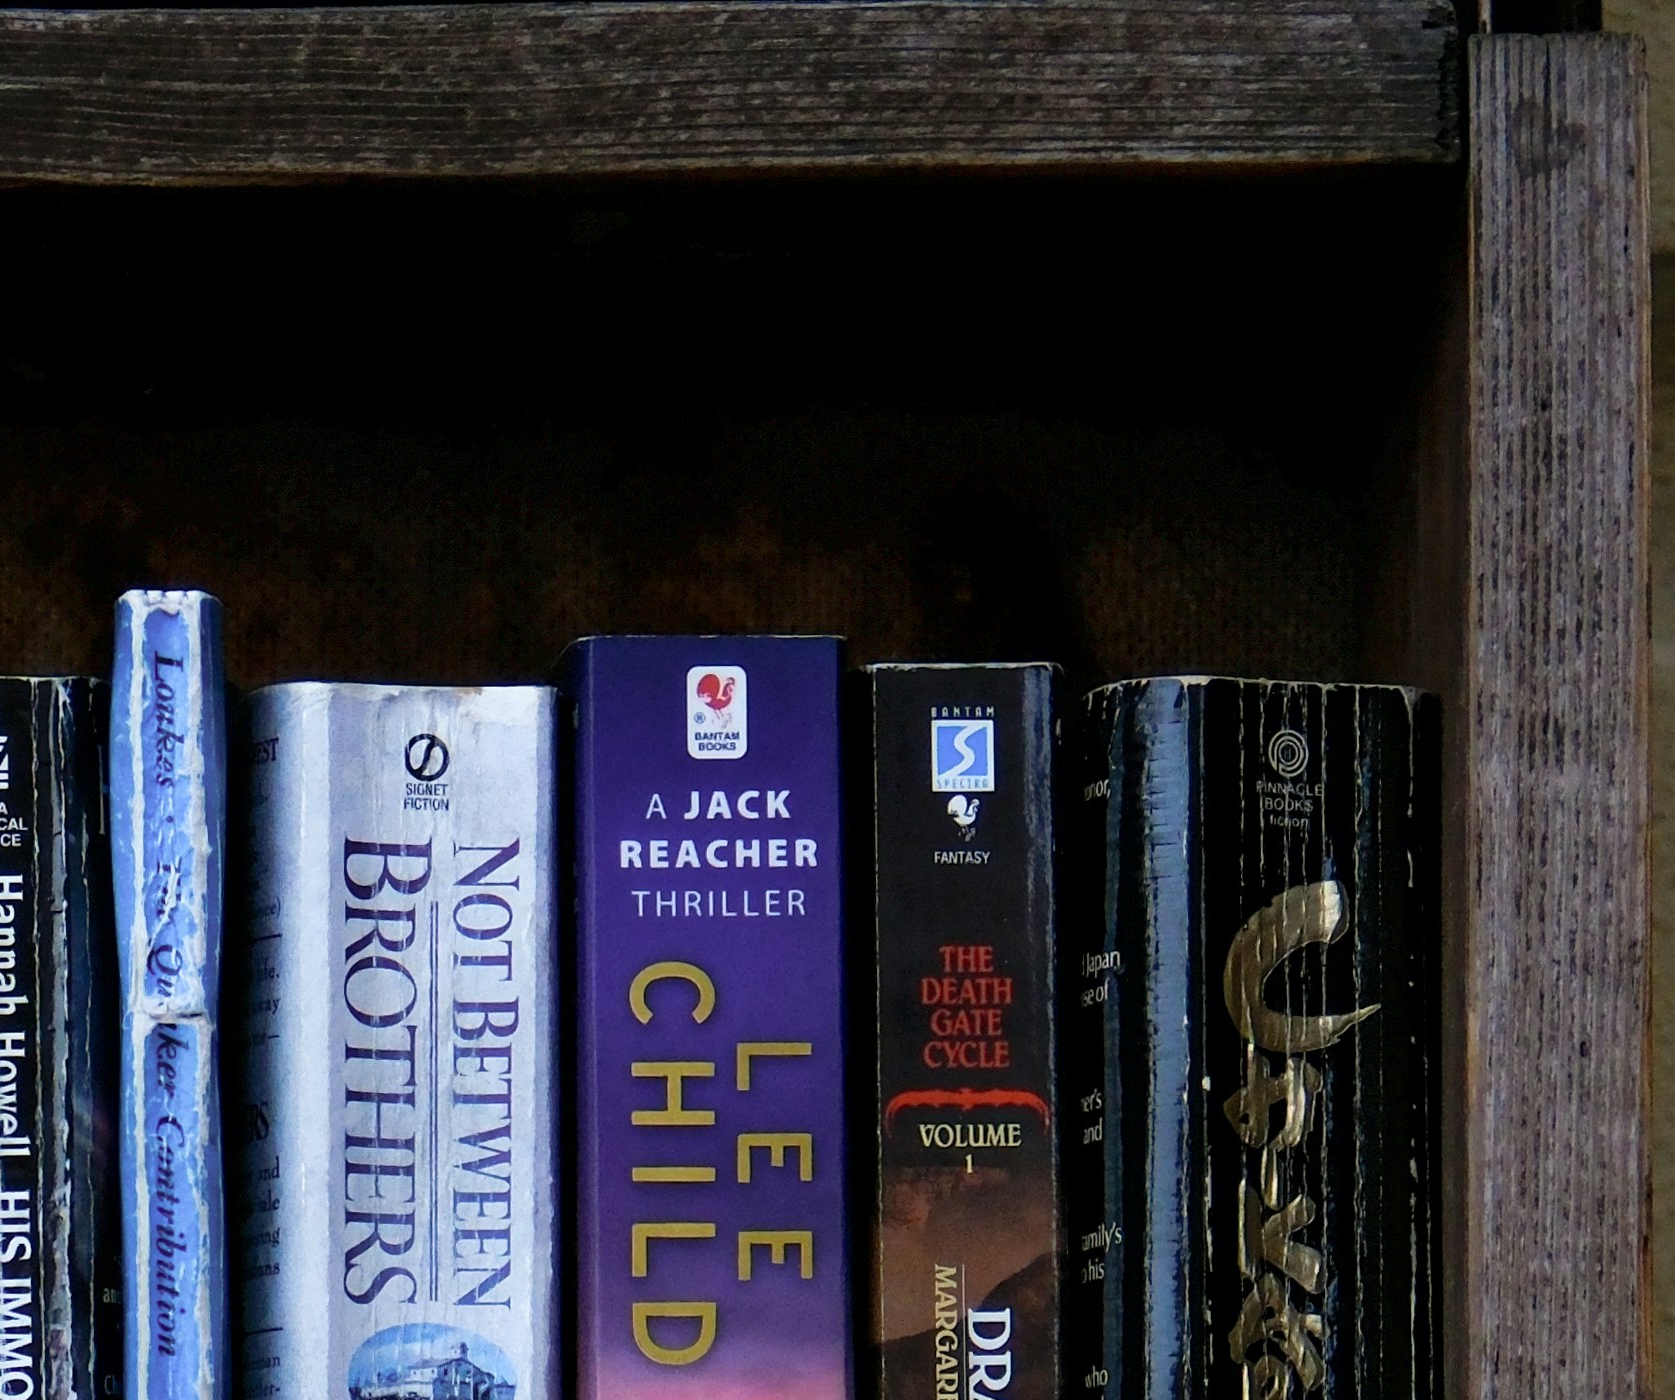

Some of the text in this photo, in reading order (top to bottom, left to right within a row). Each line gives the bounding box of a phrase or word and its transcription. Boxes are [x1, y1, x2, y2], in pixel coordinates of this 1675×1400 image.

[693, 731, 740, 742] BANTAM
[405, 782, 449, 796] SIGNET
[935, 778, 989, 790] SPECTRA
[1255, 782, 1325, 798] PINNACLE
[938, 944, 995, 974] THE
[343, 836, 433, 1306] BROTHERS
[451, 838, 522, 1310] NOT BETWEEN
[628, 959, 717, 1366] CHILD
[735, 1041, 814, 1281] LEE
